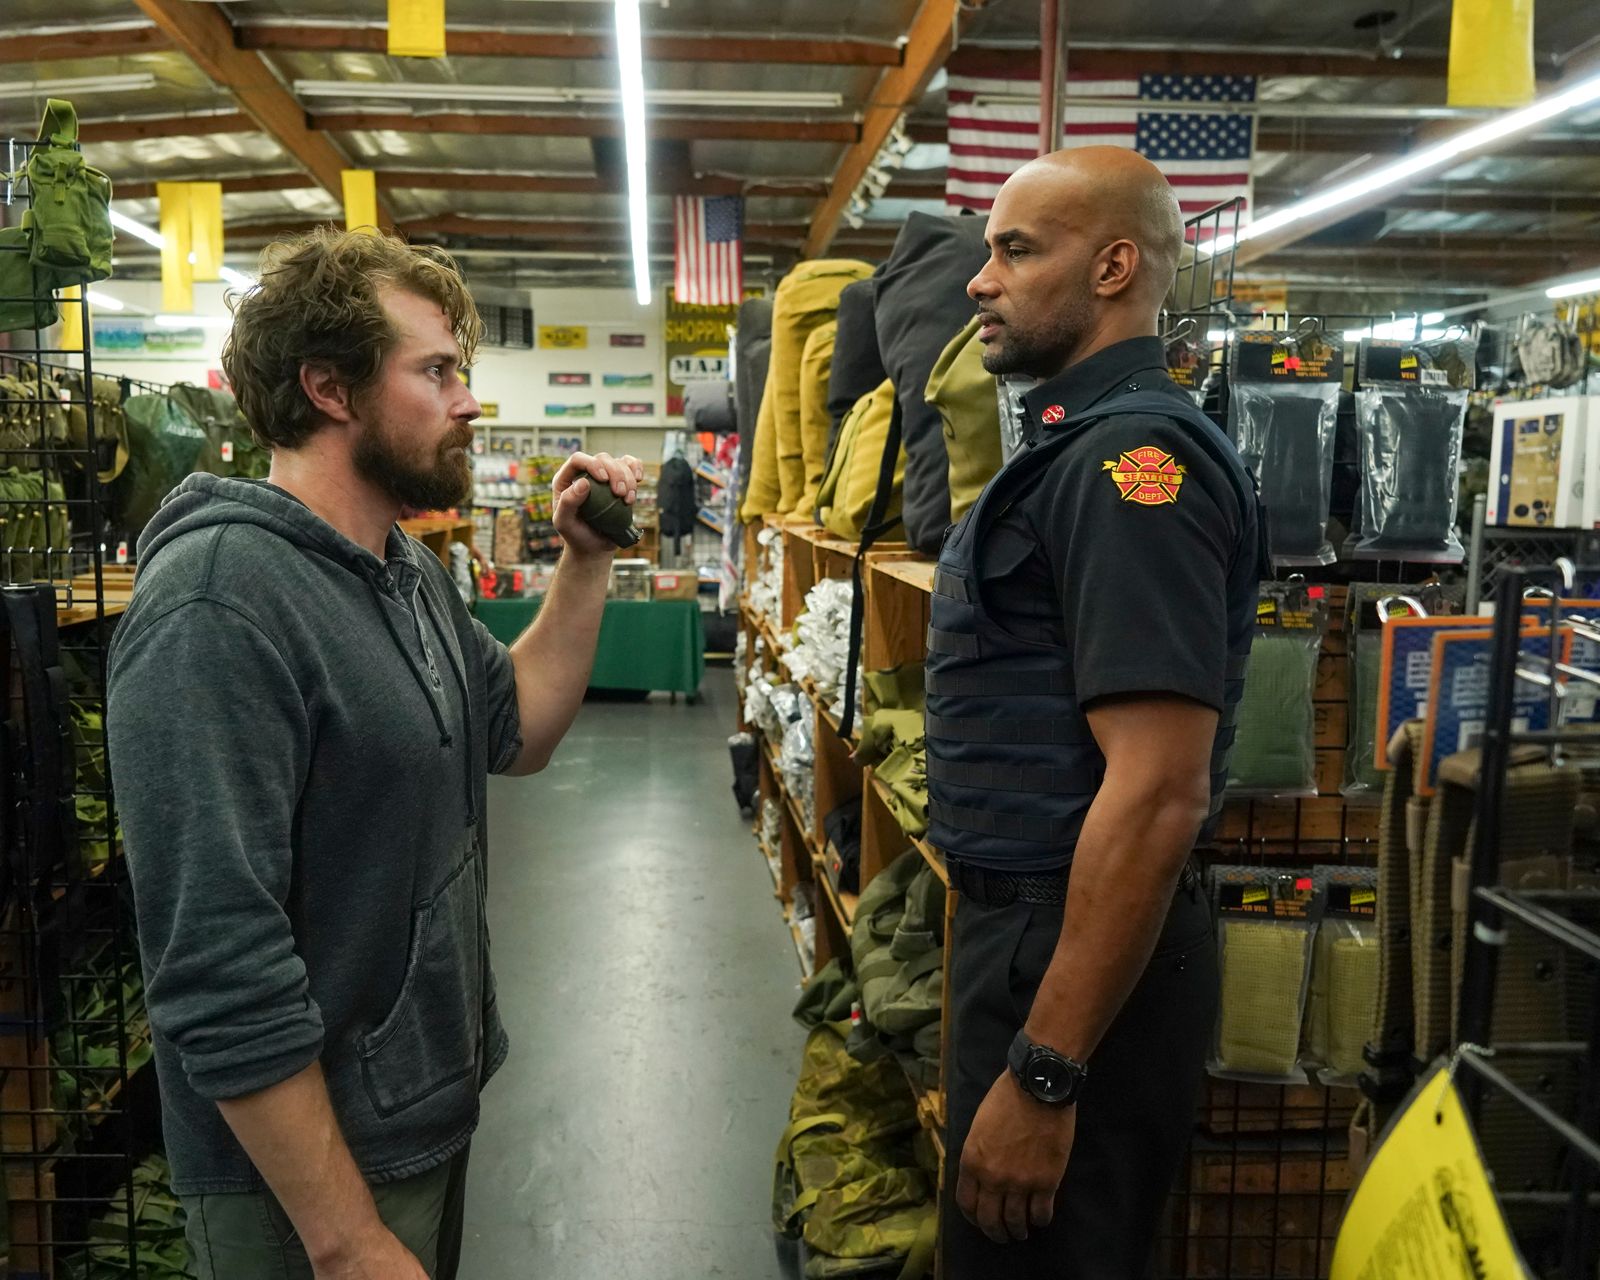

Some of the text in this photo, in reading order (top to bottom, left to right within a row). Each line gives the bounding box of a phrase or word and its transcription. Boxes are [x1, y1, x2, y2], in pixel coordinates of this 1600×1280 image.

[1138, 451, 1160, 460] FIRE
[1123, 473, 1173, 482] SEATTLE
[1138, 492, 1162, 500] DEPT
